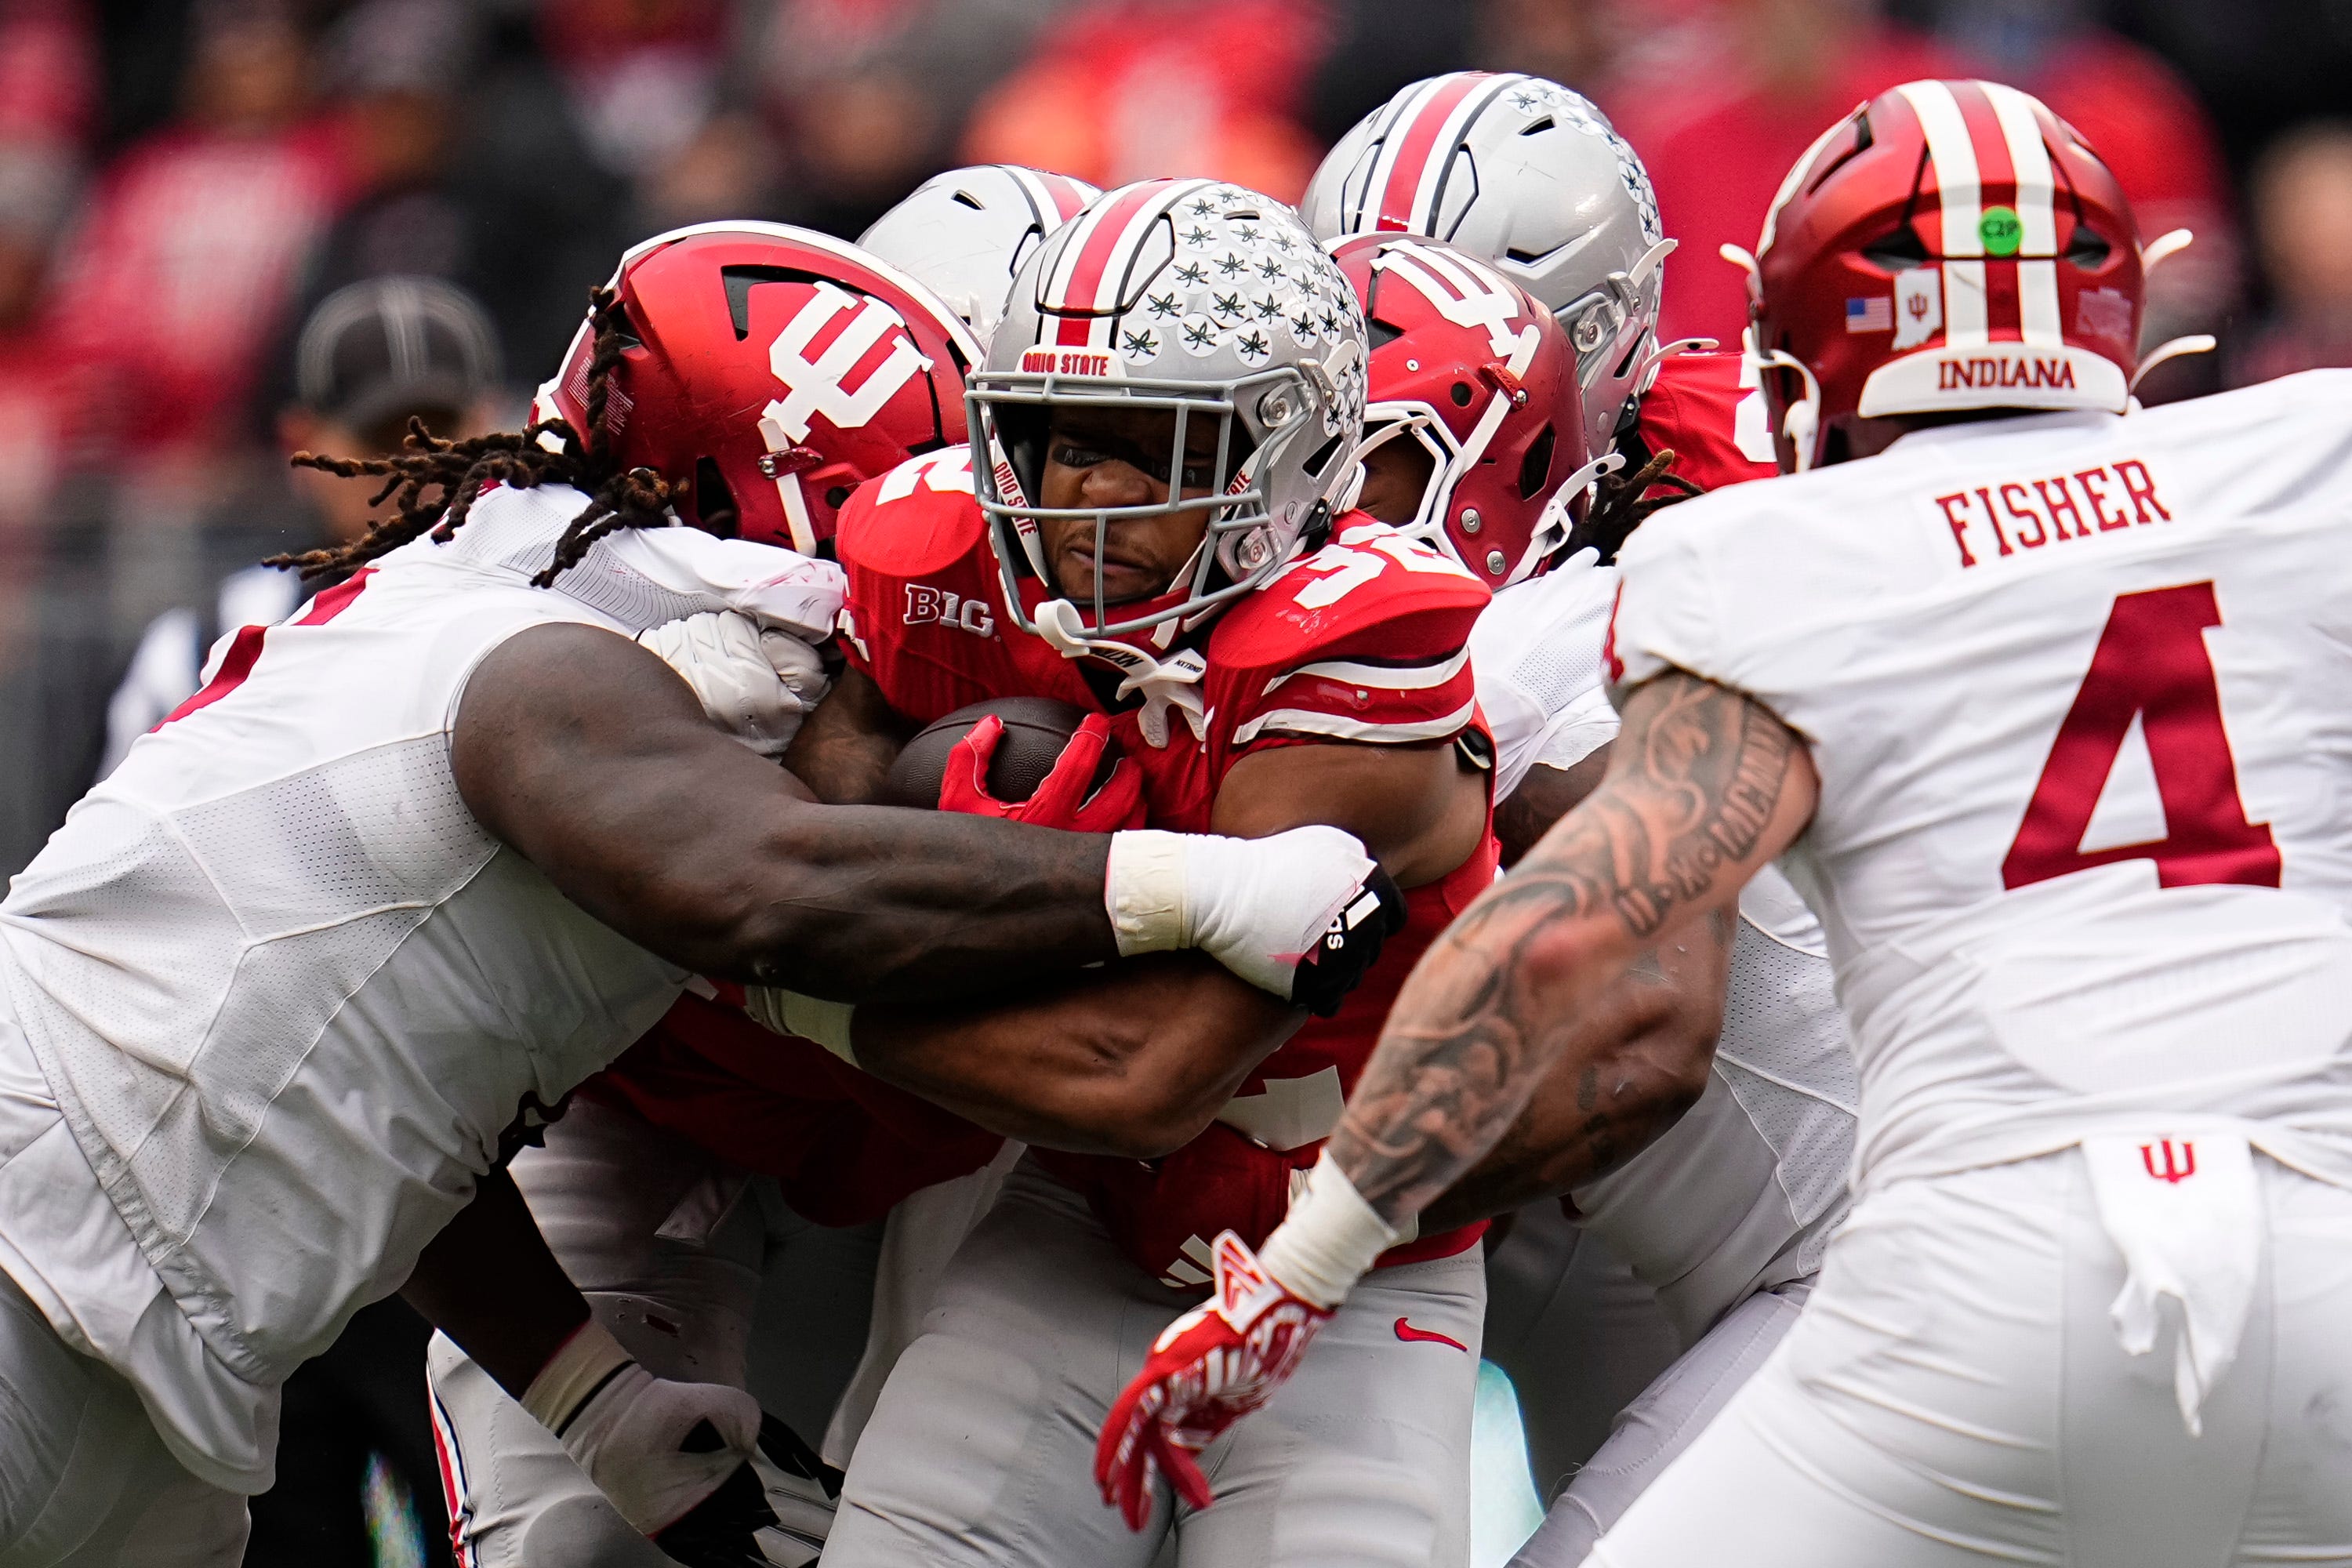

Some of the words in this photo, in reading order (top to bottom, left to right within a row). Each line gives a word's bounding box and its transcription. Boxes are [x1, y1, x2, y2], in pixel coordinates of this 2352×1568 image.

[1022, 353, 1056, 372] OHIO
[1061, 354, 1109, 376] STATE
[1939, 358, 2076, 390] INDIANA
[995, 461, 1018, 495] OHIO
[1007, 495, 1037, 536] STE
[1935, 459, 2172, 567] FISHER
[2001, 579, 2281, 889] 4
